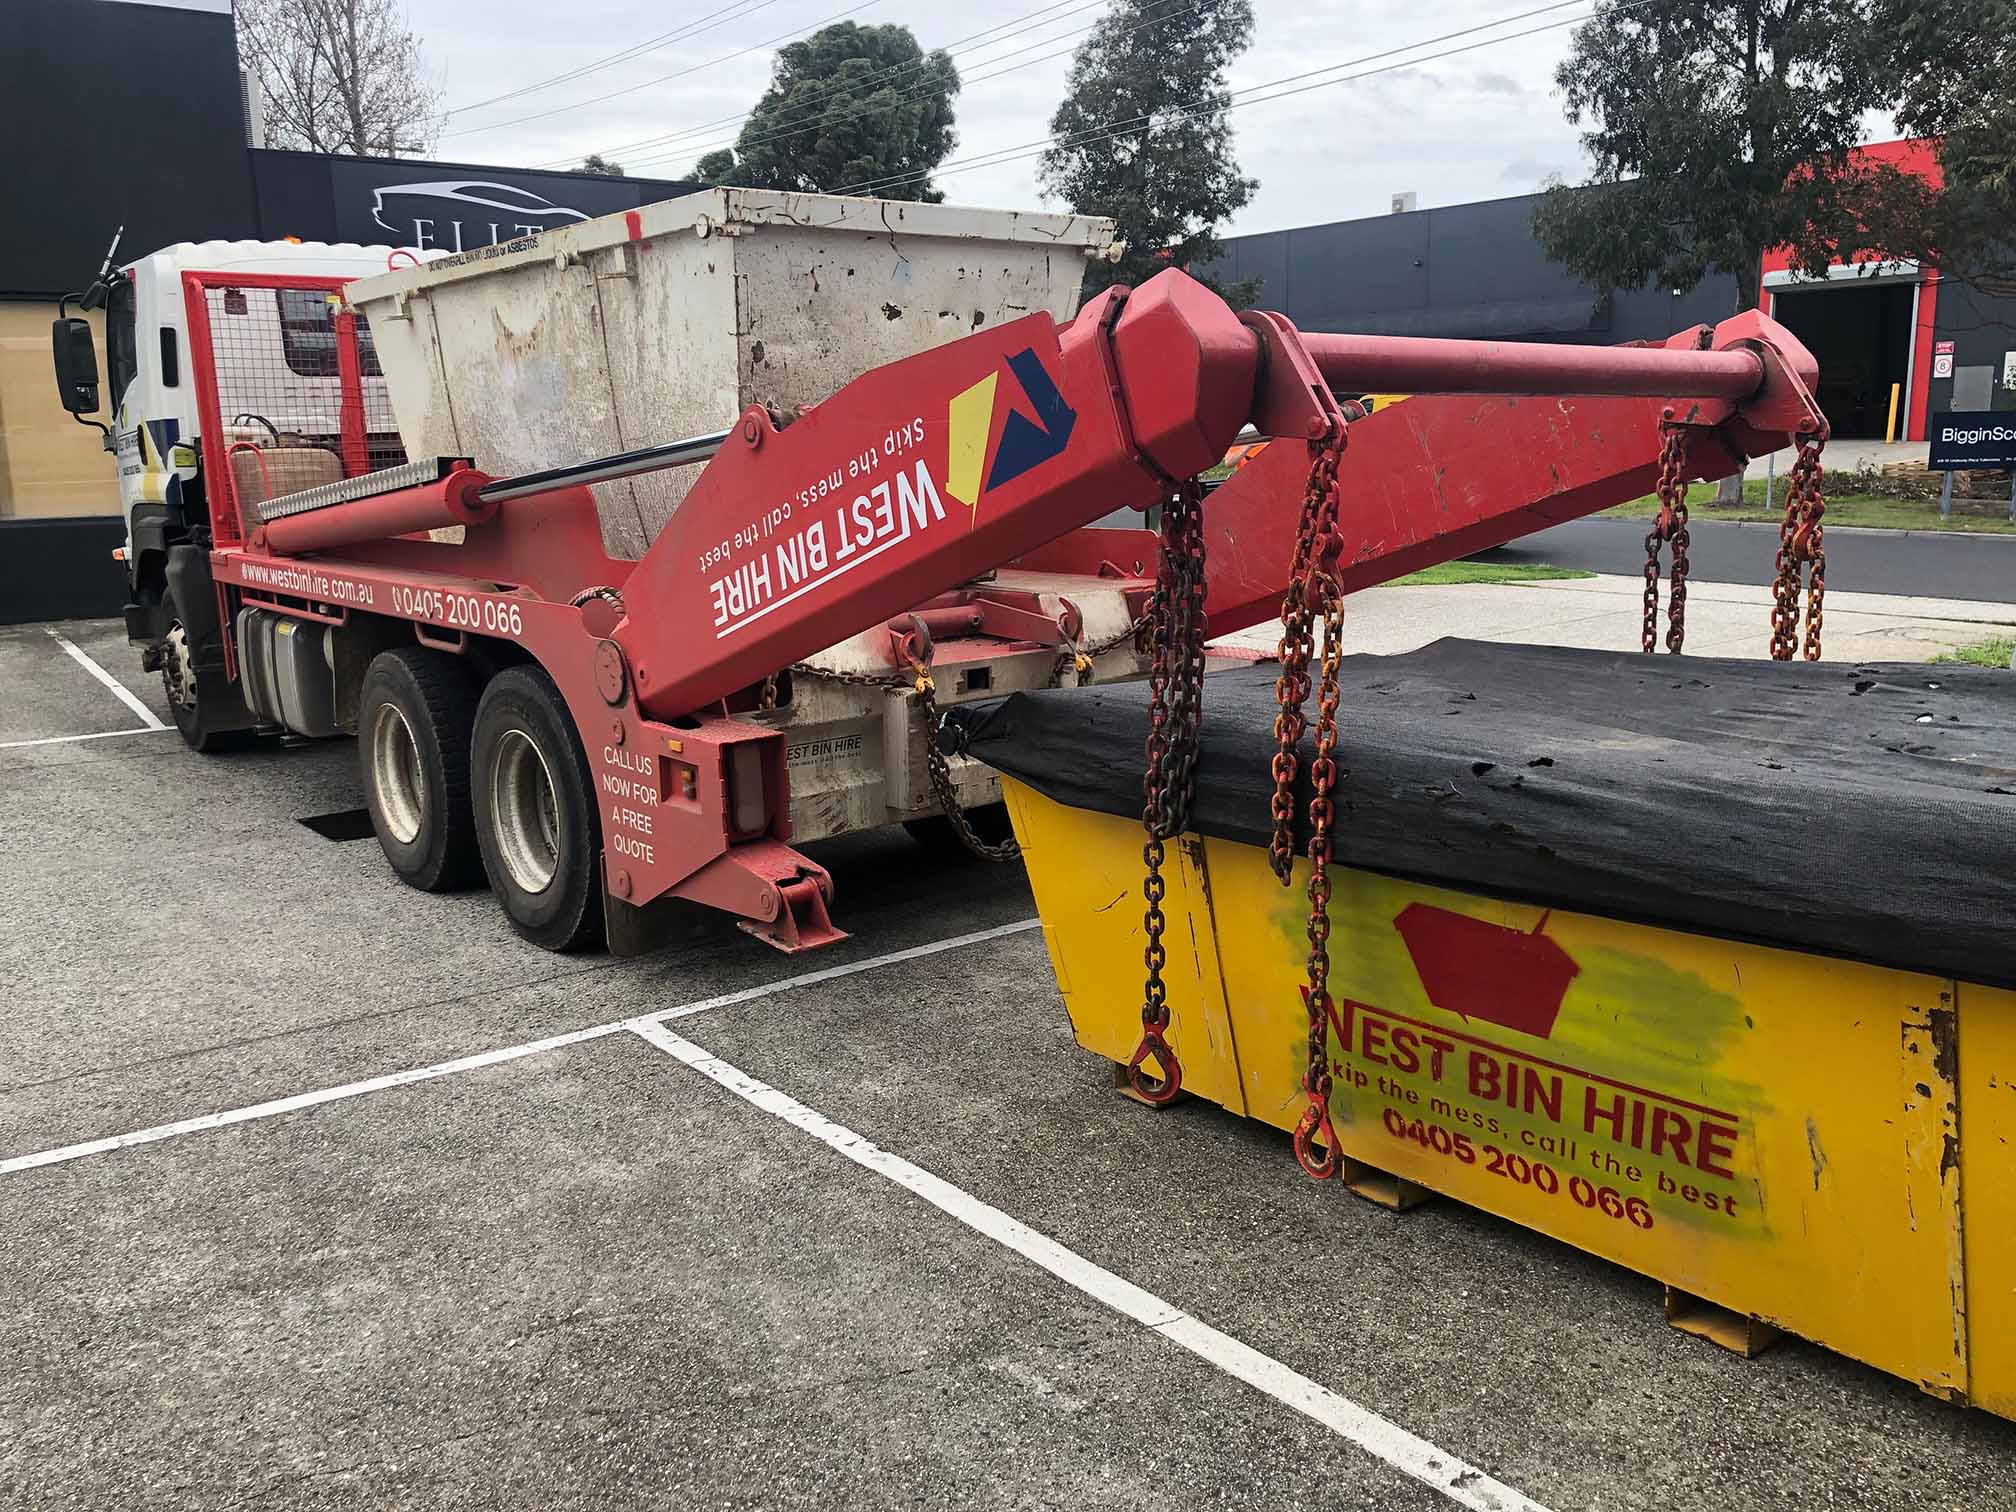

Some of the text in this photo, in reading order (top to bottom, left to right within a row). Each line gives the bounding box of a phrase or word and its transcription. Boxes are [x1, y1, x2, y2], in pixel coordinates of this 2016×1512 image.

[507, 236, 540, 255] ASBESTOS
[1941, 426, 2016, 445] BigginSc
[848, 447, 879, 478] the
[795, 468, 843, 508] mess,
[734, 523, 759, 549] the
[762, 502, 792, 538] call
[699, 540, 731, 574] best
[709, 458, 946, 628] WEST BIN HIRE
[402, 586, 522, 636] 0405 200 066
[603, 745, 653, 776] CALL US
[786, 744, 809, 761] EST
[811, 741, 832, 757] BIN
[834, 737, 862, 753] HIRE
[602, 773, 659, 808] NOW FOR
[611, 804, 653, 835] A FREE
[613, 833, 655, 865] QUOTE
[1468, 1049, 1563, 1124] BIN
[1583, 1085, 1739, 1181] HIRE
[1327, 1058, 1739, 1218] kip the mess, call the best
[1383, 1107, 1655, 1230] 0405 200 066
